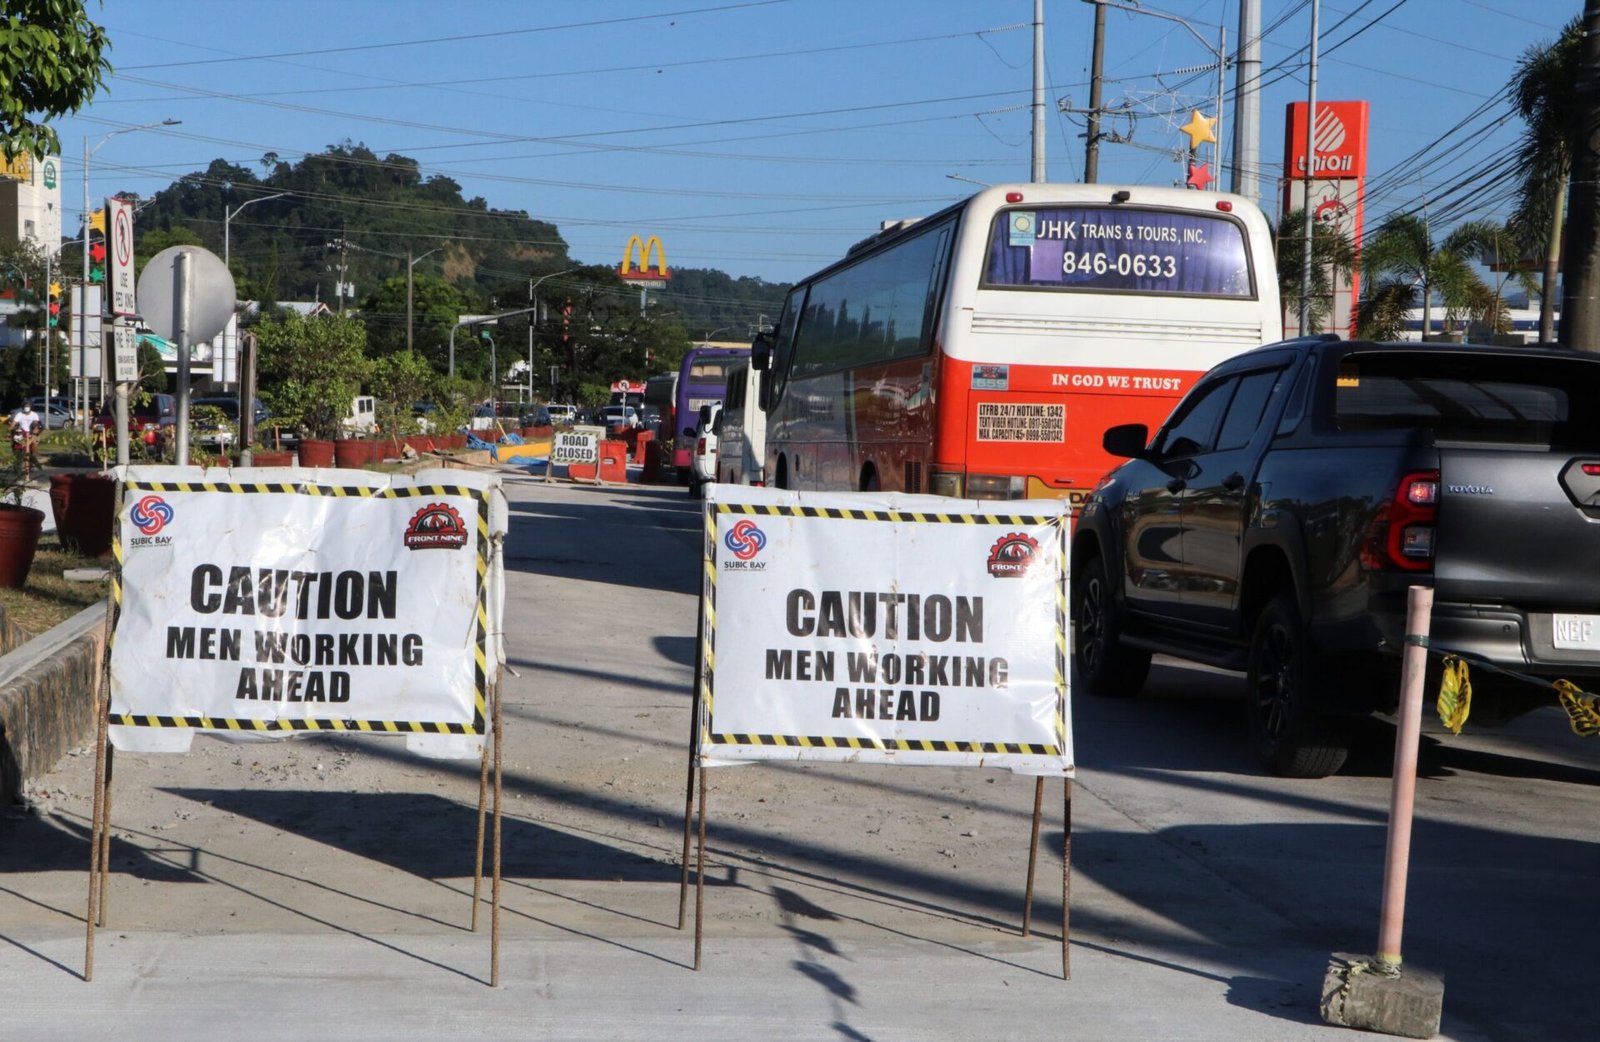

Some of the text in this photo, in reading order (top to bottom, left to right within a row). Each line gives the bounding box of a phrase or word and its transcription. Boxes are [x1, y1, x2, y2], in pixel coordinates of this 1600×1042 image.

[1037, 220, 1077, 240] JHK
[1082, 223, 1122, 240] TRANS
[1125, 226, 1134, 240] &
[1183, 228, 1207, 244] INC.
[1062, 251, 1177, 278] 846-0633
[1052, 373, 1182, 391] IN GOD WE TRUST
[979, 404, 999, 416] LTFRB
[1000, 404, 1016, 416] 24/7
[1047, 406, 1063, 417] 1342
[562, 435, 588, 447] ROAD
[556, 447, 593, 459] CLOSED
[1447, 484, 1493, 494] TOYOTA
[130, 536, 153, 546] SUBIC
[155, 535, 173, 544] BAY
[408, 534, 464, 543] FRONT NINE
[724, 560, 766, 569] SUBIC BAY
[190, 563, 398, 620] CAUTION
[786, 588, 984, 644] CAUTION
[166, 625, 424, 667] MEN WORKING
[765, 648, 1009, 689] MEN WORKING
[235, 667, 350, 703] AHEAD
[831, 687, 941, 722] AHEAD
